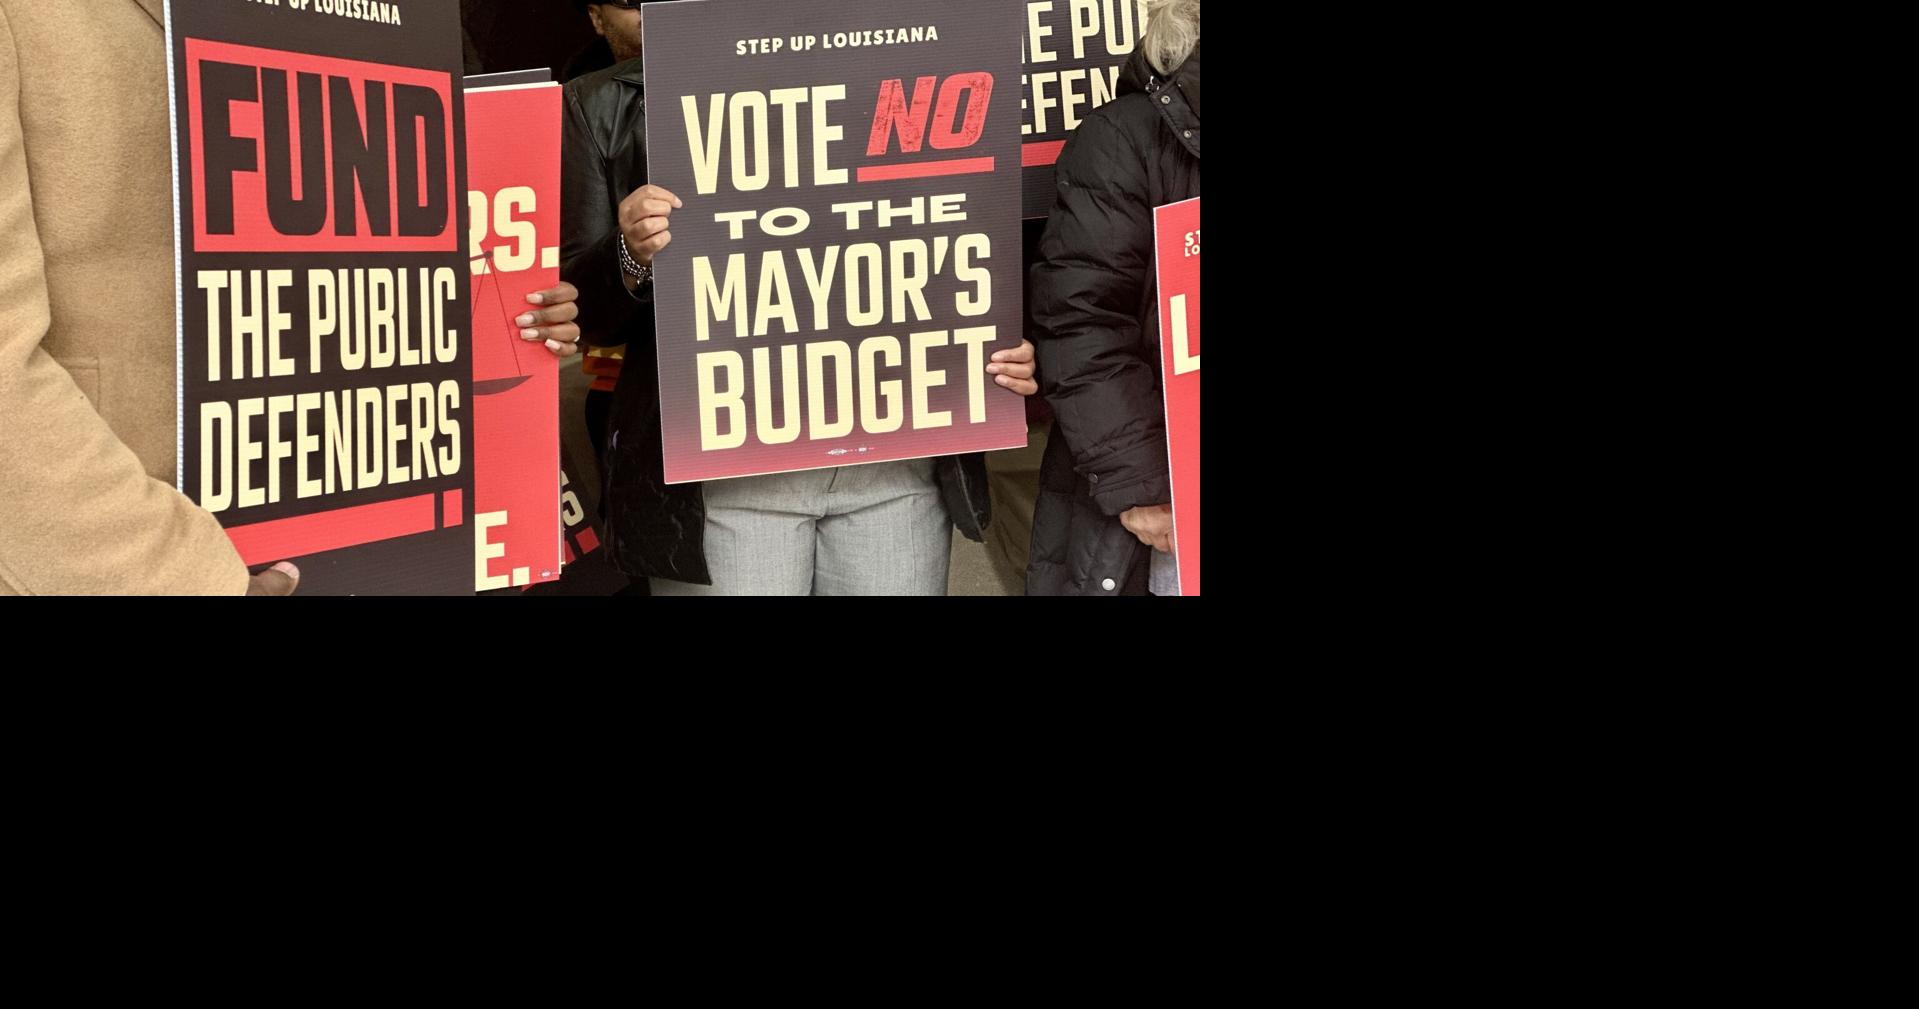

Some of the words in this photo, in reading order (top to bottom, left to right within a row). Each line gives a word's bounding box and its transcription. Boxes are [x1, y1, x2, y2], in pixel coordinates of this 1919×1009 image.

[314, 0, 401, 25] LOUISIANA
[736, 39, 783, 55] STEP
[790, 35, 816, 50] UP
[823, 26, 938, 49] LOUISIANA
[1022, 1, 1057, 63] E
[198, 59, 449, 237] FUND
[681, 84, 848, 195] VOTE
[866, 71, 994, 156] NO
[715, 207, 811, 240] TO
[832, 193, 967, 231] THE
[197, 270, 295, 382] THE
[308, 267, 457, 374] PUBLIC
[692, 233, 992, 342] MAYOR'S
[697, 325, 997, 452] BUDGET
[200, 379, 462, 513] DEFENDERS
